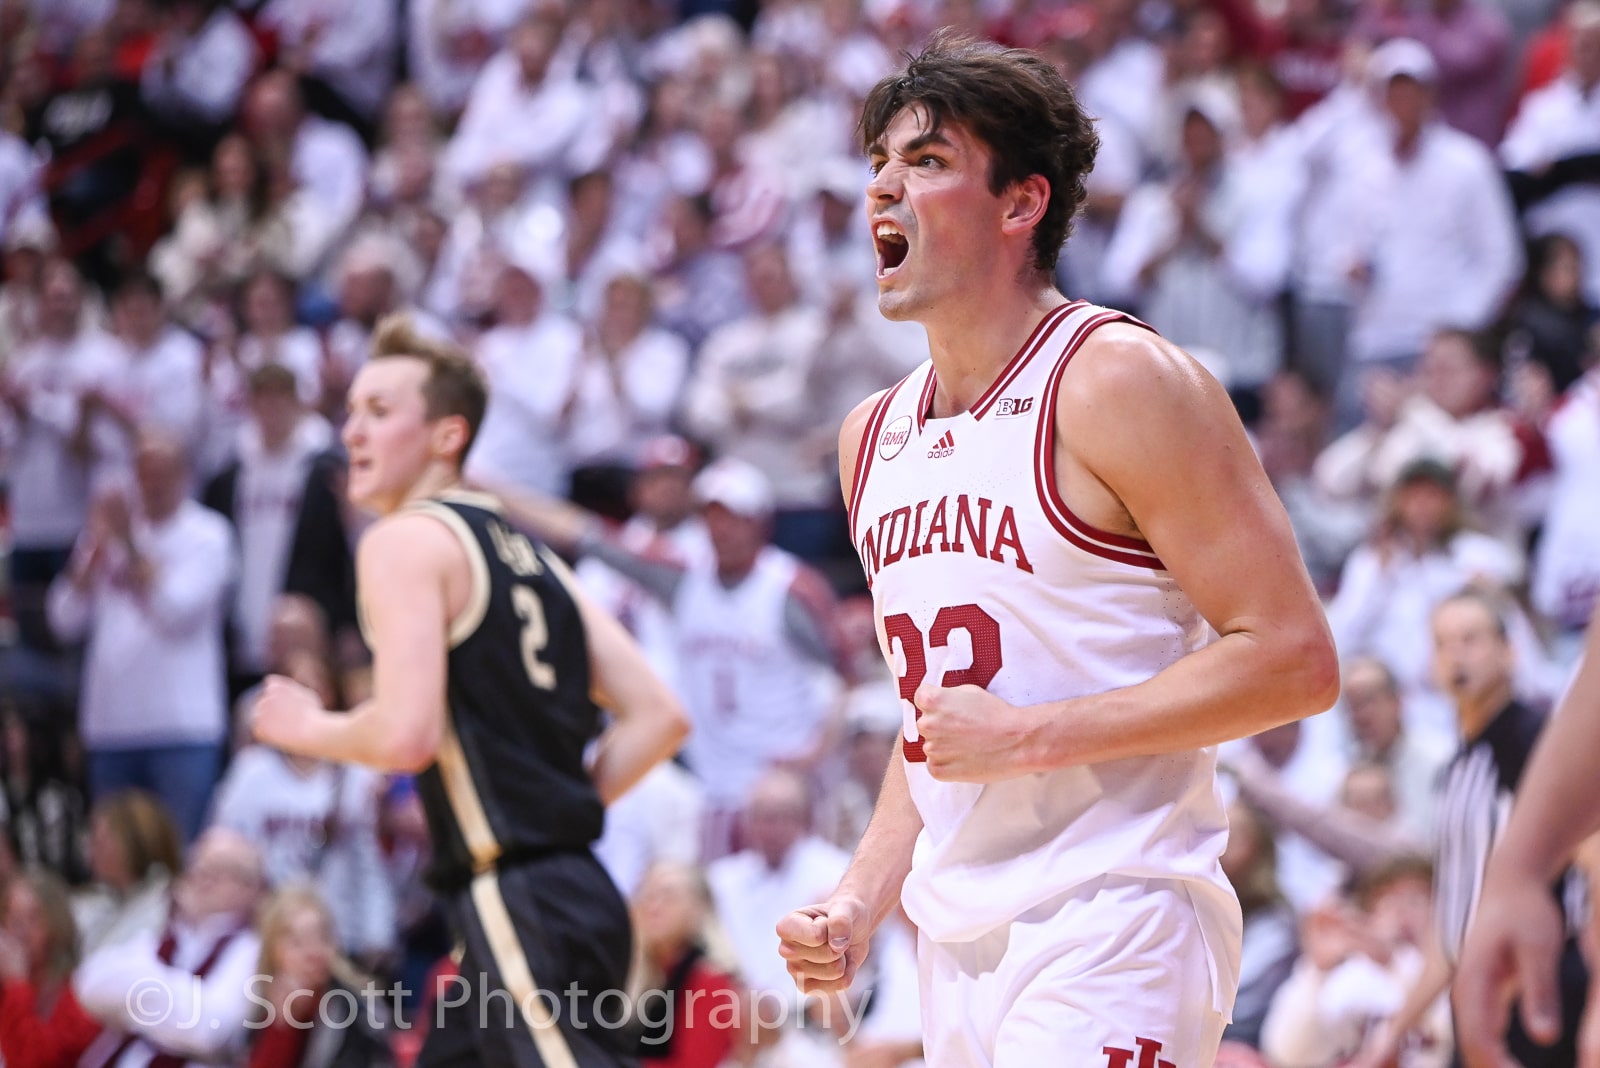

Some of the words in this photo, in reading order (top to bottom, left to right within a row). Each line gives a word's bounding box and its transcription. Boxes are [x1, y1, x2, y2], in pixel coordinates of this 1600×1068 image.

[881, 430, 908, 446] RMK
[927, 447, 955, 459] adida
[510, 583, 558, 690] 2
[884, 604, 1003, 763] 33
